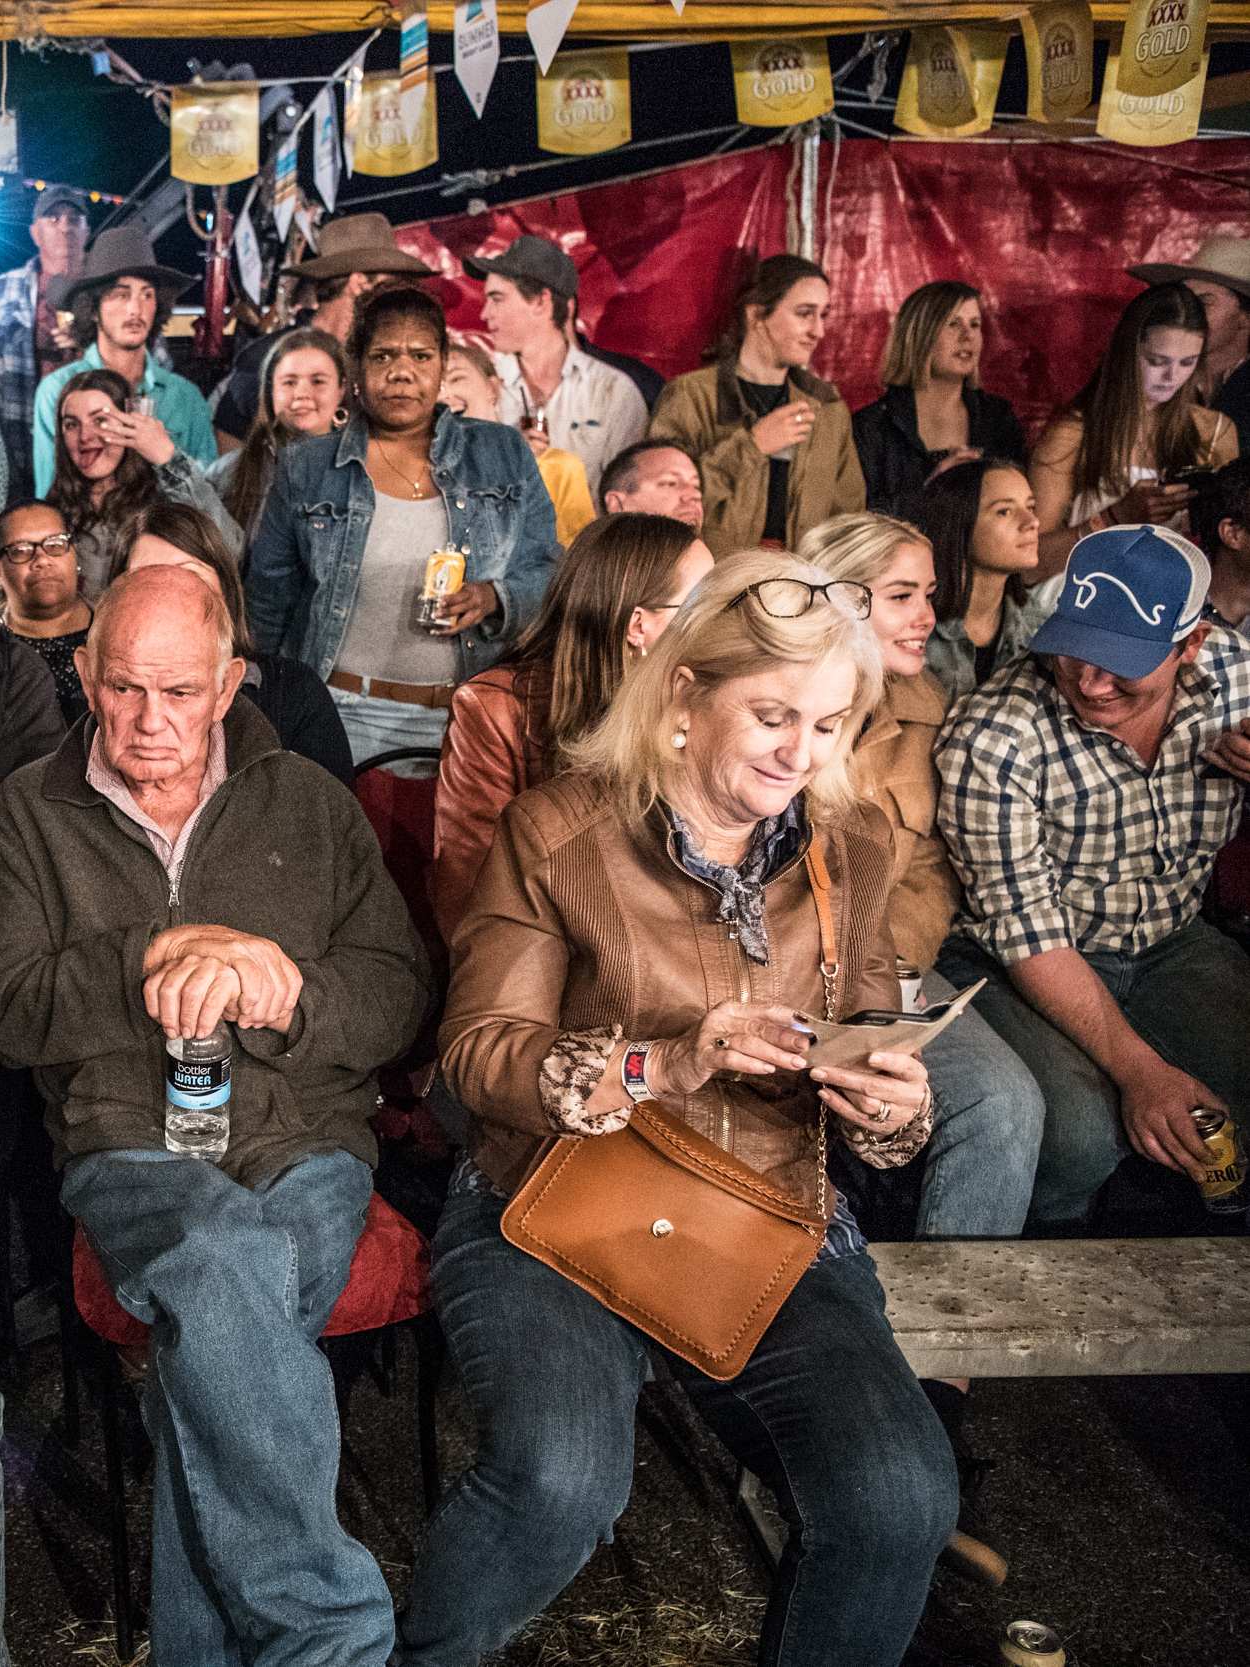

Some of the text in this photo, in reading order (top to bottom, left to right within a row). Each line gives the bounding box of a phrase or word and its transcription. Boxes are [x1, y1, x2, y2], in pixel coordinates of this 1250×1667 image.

[1147, 3, 1187, 29] XXXX
[1135, 24, 1191, 62] GOLD
[761, 57, 803, 73] XXXX
[564, 84, 605, 102] XXXX
[753, 71, 815, 99] GOLD
[554, 101, 615, 127] GOLD
[1119, 92, 1184, 116] GOLD
[174, 1072, 212, 1086] WATER
[178, 1062, 212, 1075] bottler
